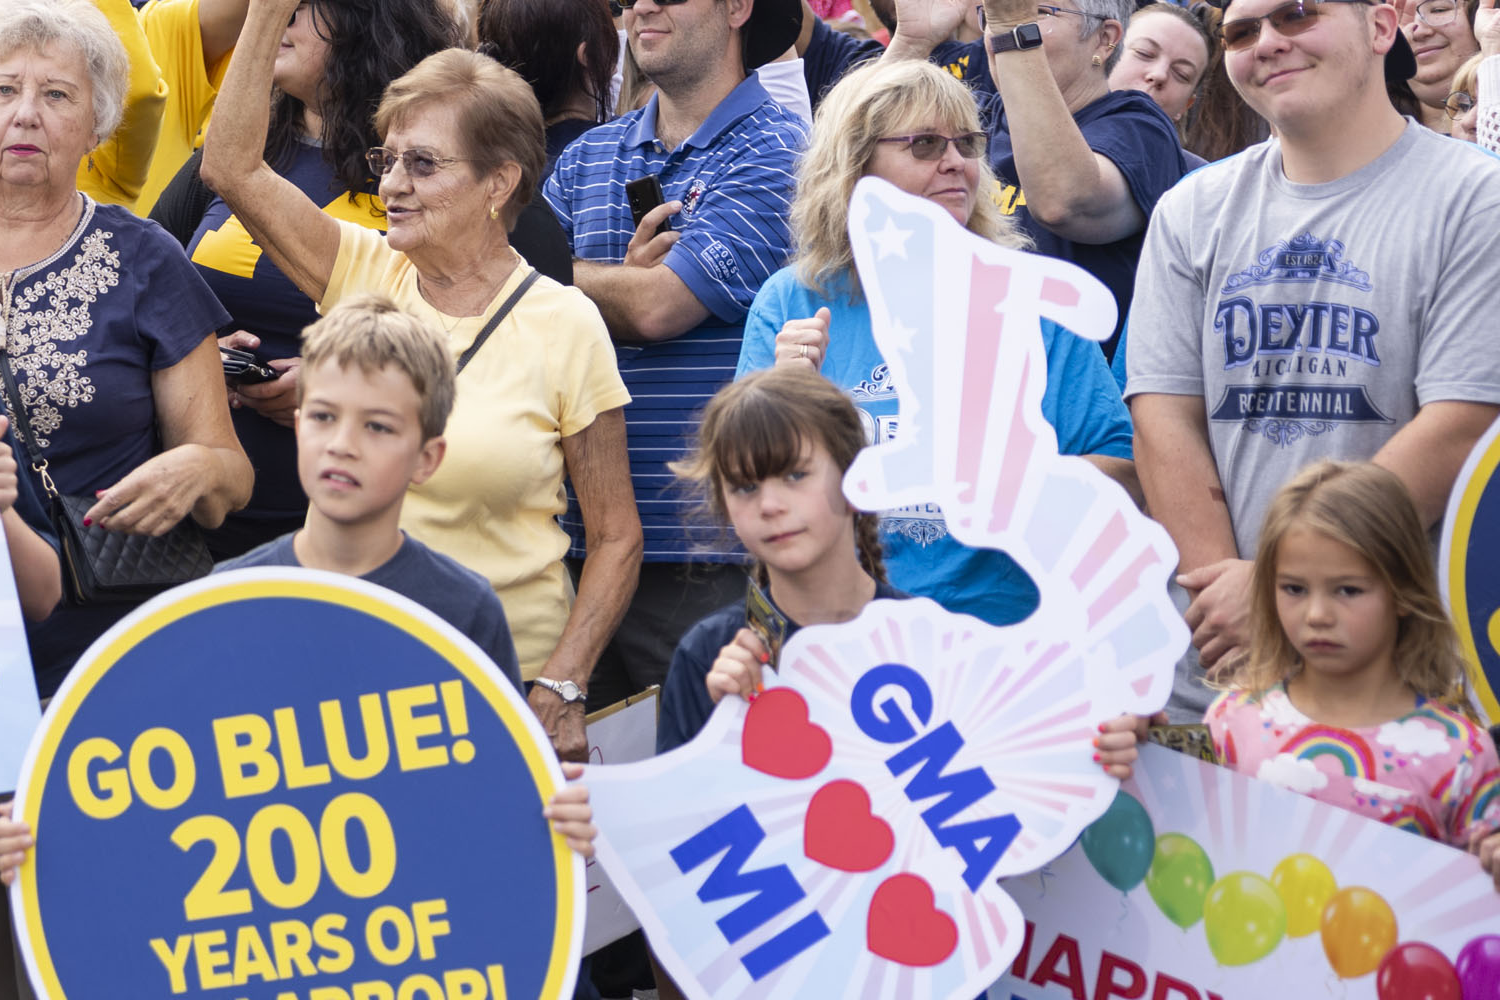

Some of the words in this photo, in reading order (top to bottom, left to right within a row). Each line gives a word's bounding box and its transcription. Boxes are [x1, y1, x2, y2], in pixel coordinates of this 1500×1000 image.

[713, 243, 738, 274] 2005
[1213, 295, 1382, 371] DEXTER
[68, 728, 196, 820] GO
[213, 680, 476, 799] BLUE!
[850, 663, 1023, 894] GMA
[170, 792, 397, 921] 200
[668, 803, 831, 982] MI
[150, 914, 354, 993] YEARS
[366, 900, 450, 965] OF
